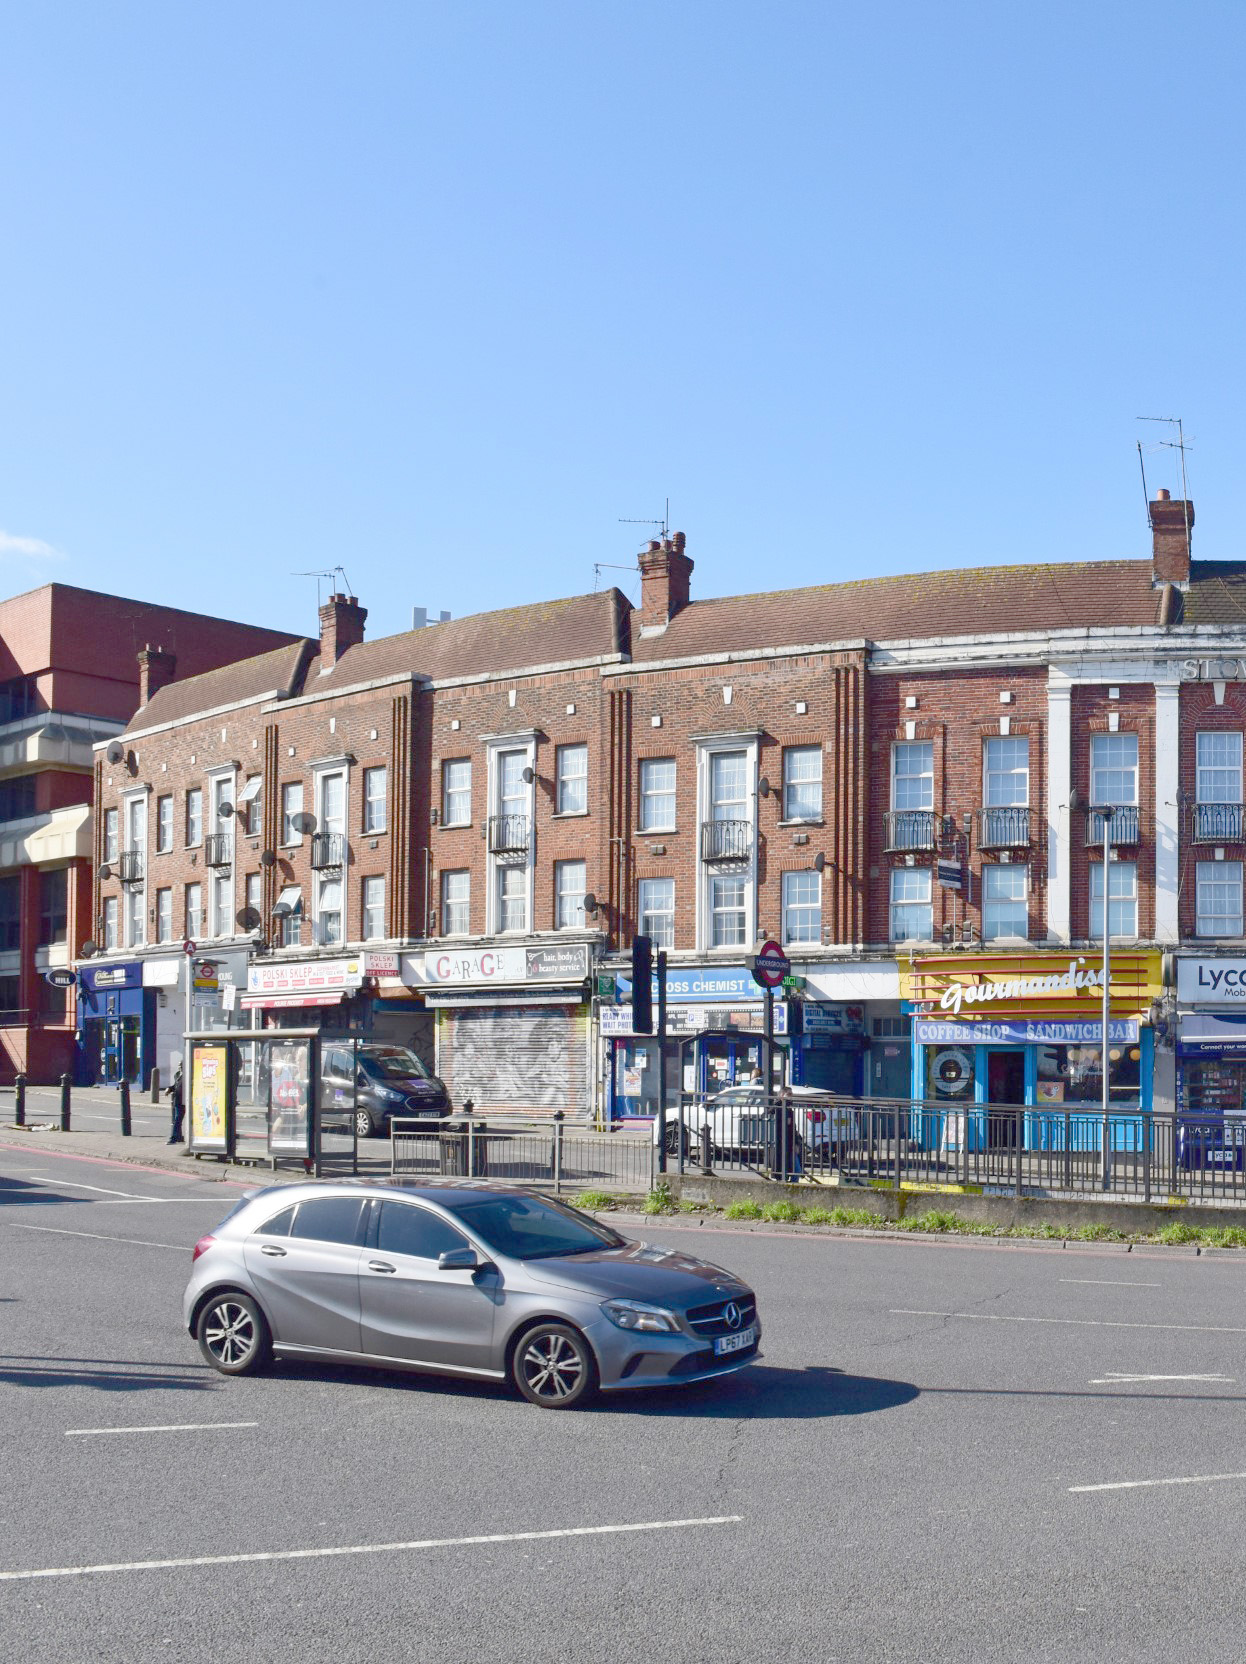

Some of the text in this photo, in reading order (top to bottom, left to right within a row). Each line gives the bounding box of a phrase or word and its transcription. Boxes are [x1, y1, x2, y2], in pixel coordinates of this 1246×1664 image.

[186, 943, 194, 952] A
[557, 952, 573, 962] body
[539, 963, 580, 973] beauty service
[756, 960, 789, 969] UNDERGROUND
[262, 969, 287, 980] POLSKI
[290, 966, 313, 978] SKLEP
[651, 980, 745, 993] COSS CHEMIST
[602, 1021, 632, 1029] WAIT PHOT
[918, 1025, 970, 1040] COFFEE
[973, 1024, 1010, 1040] SHOP
[1026, 1024, 1101, 1040] SANDWICH
[720, 1334, 741, 1352] LP67
